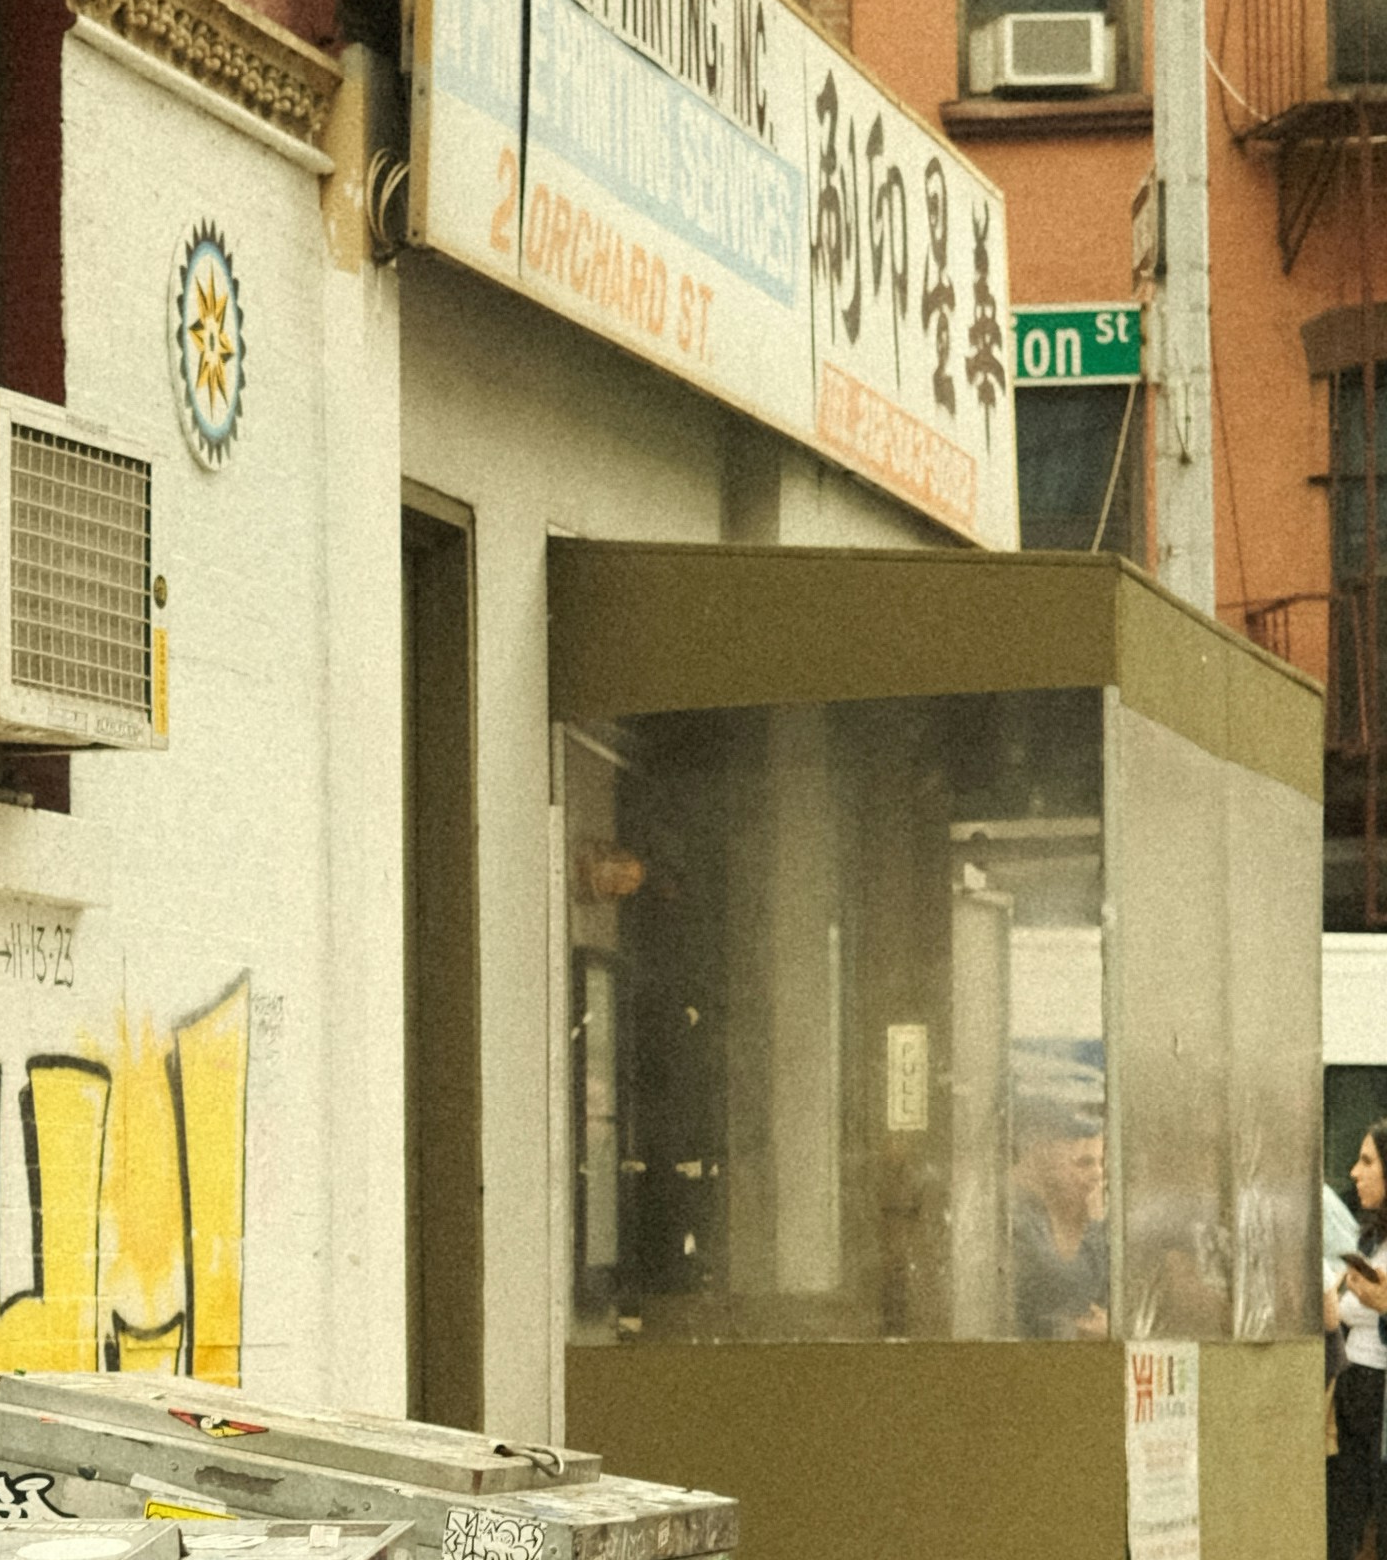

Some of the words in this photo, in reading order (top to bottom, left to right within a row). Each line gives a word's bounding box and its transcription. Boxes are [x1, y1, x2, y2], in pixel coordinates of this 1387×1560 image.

[489, 147, 519, 255] 2
[527, 183, 669, 337] ORCHARD
[1095, 312, 1130, 345] St
[901, 1040, 917, 1115] PULL
